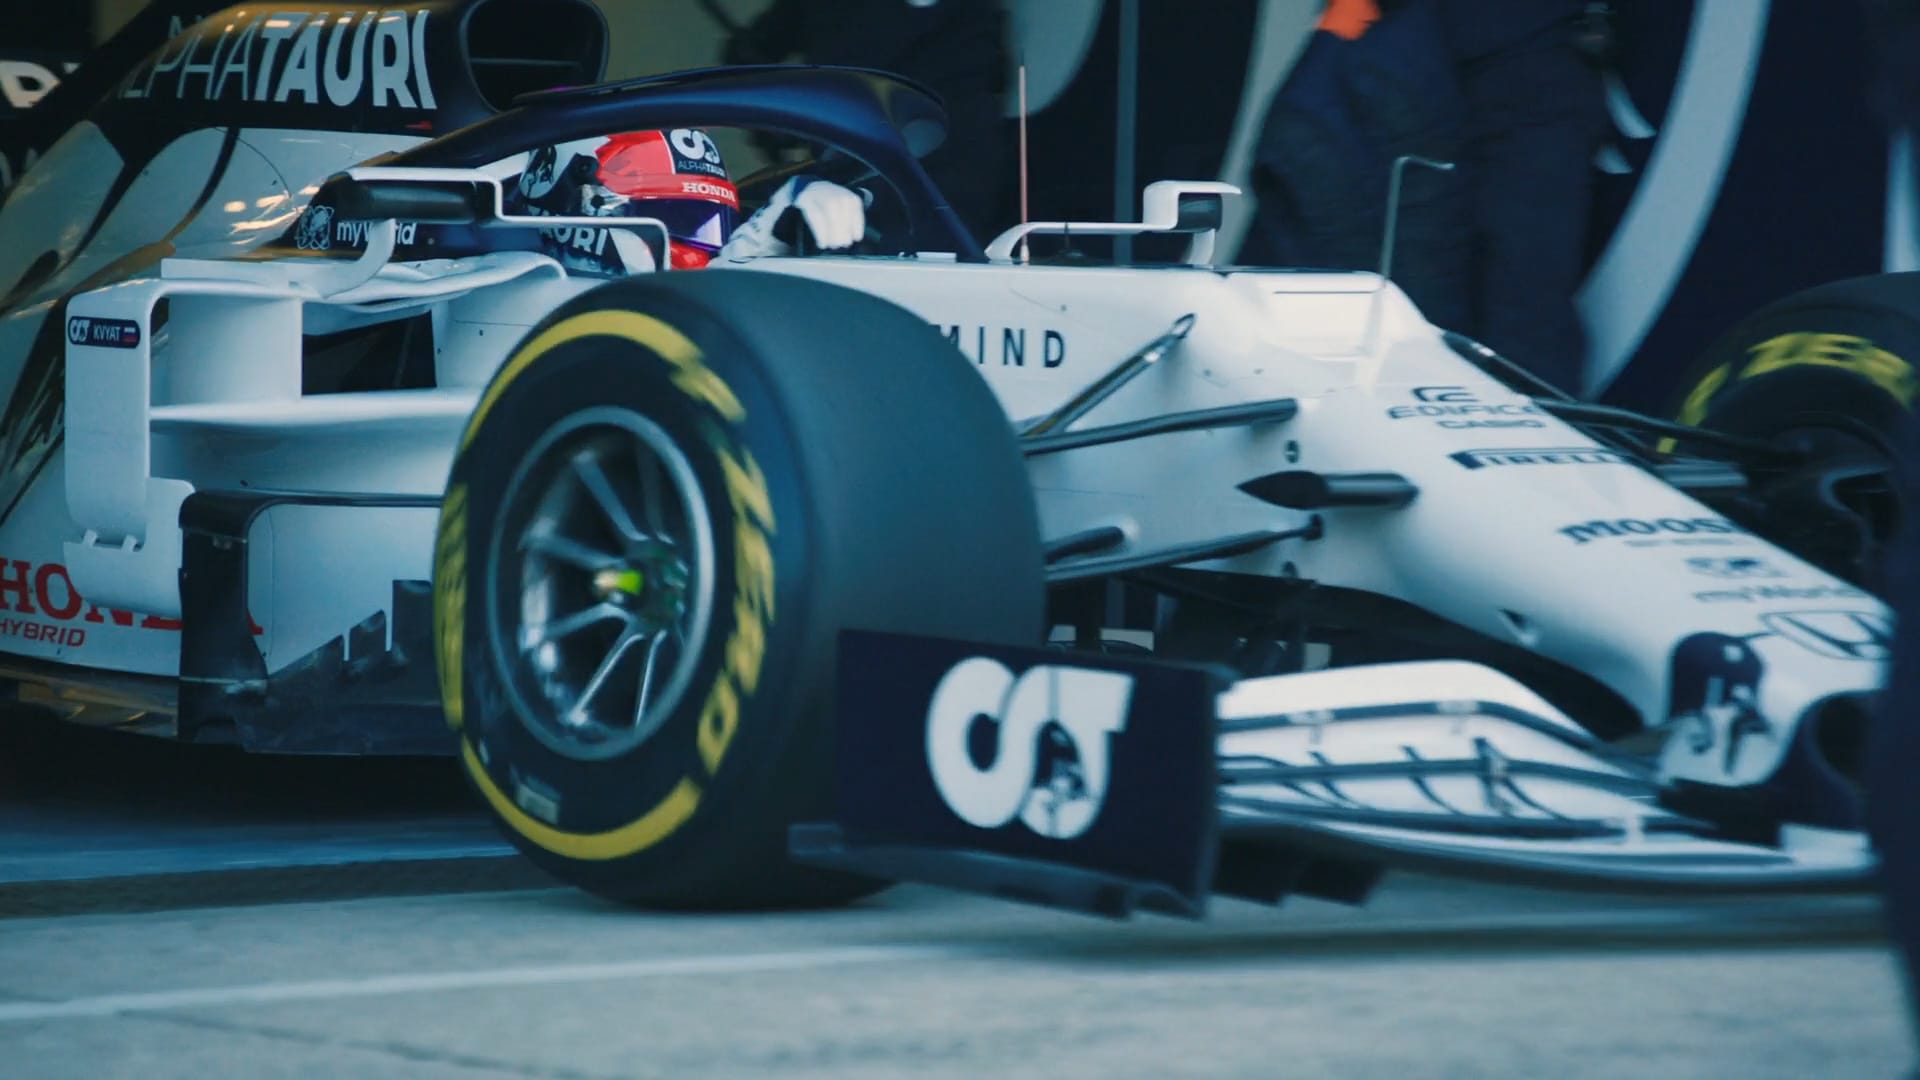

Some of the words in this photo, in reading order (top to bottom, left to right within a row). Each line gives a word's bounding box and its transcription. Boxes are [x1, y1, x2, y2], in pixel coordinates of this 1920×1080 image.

[118, 9, 438, 110] LPHATAURI
[682, 182, 736, 202] HONDA
[336, 221, 417, 248] myld
[92, 325, 121, 342] KVYAT
[1447, 446, 1626, 471] PIRELL
[1558, 517, 1740, 545] MOOS
[0, 618, 86, 648] HYBRID
